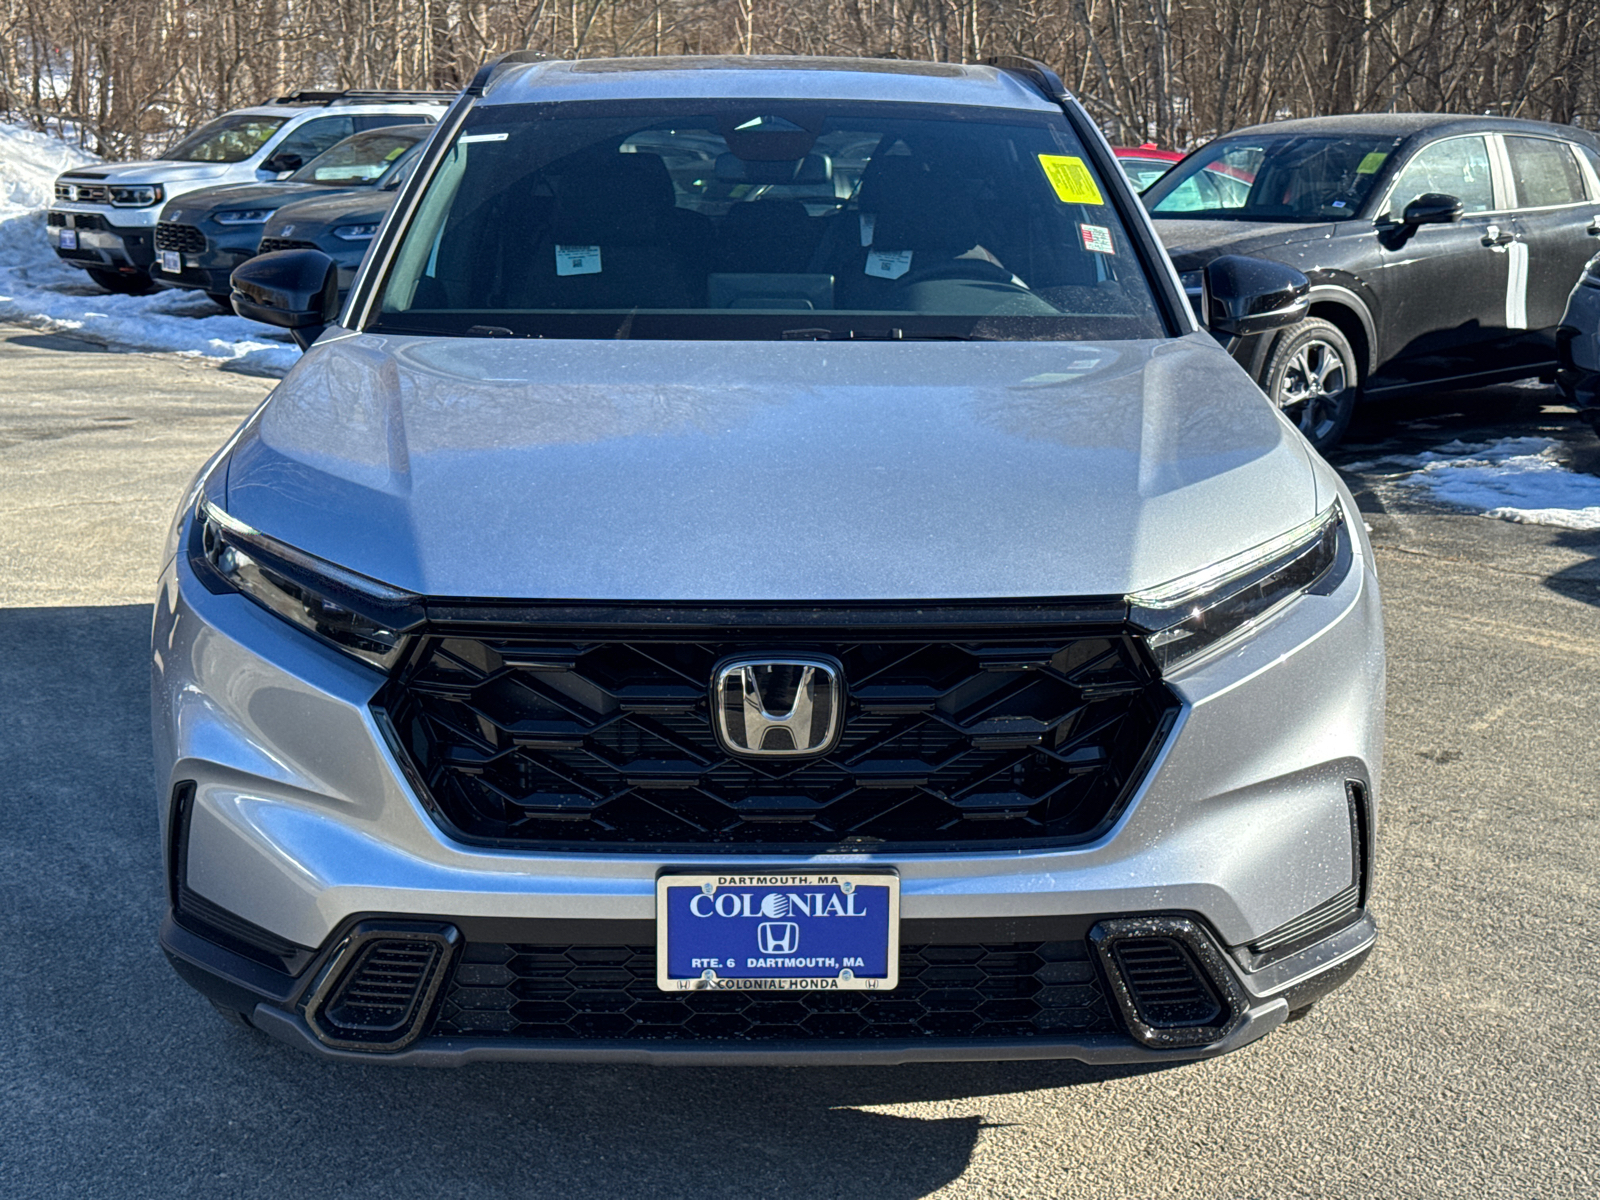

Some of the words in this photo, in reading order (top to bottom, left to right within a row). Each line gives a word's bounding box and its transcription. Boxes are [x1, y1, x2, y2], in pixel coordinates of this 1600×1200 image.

[817, 876, 839, 884] MA
[689, 892, 867, 919] COLONIAL
[691, 958, 723, 968] RTE.
[726, 958, 736, 968] 6
[747, 957, 839, 969] DARTMOUTH,
[843, 957, 865, 968] MA
[717, 979, 785, 989] COLONIAL
[789, 979, 839, 989] HONDA
